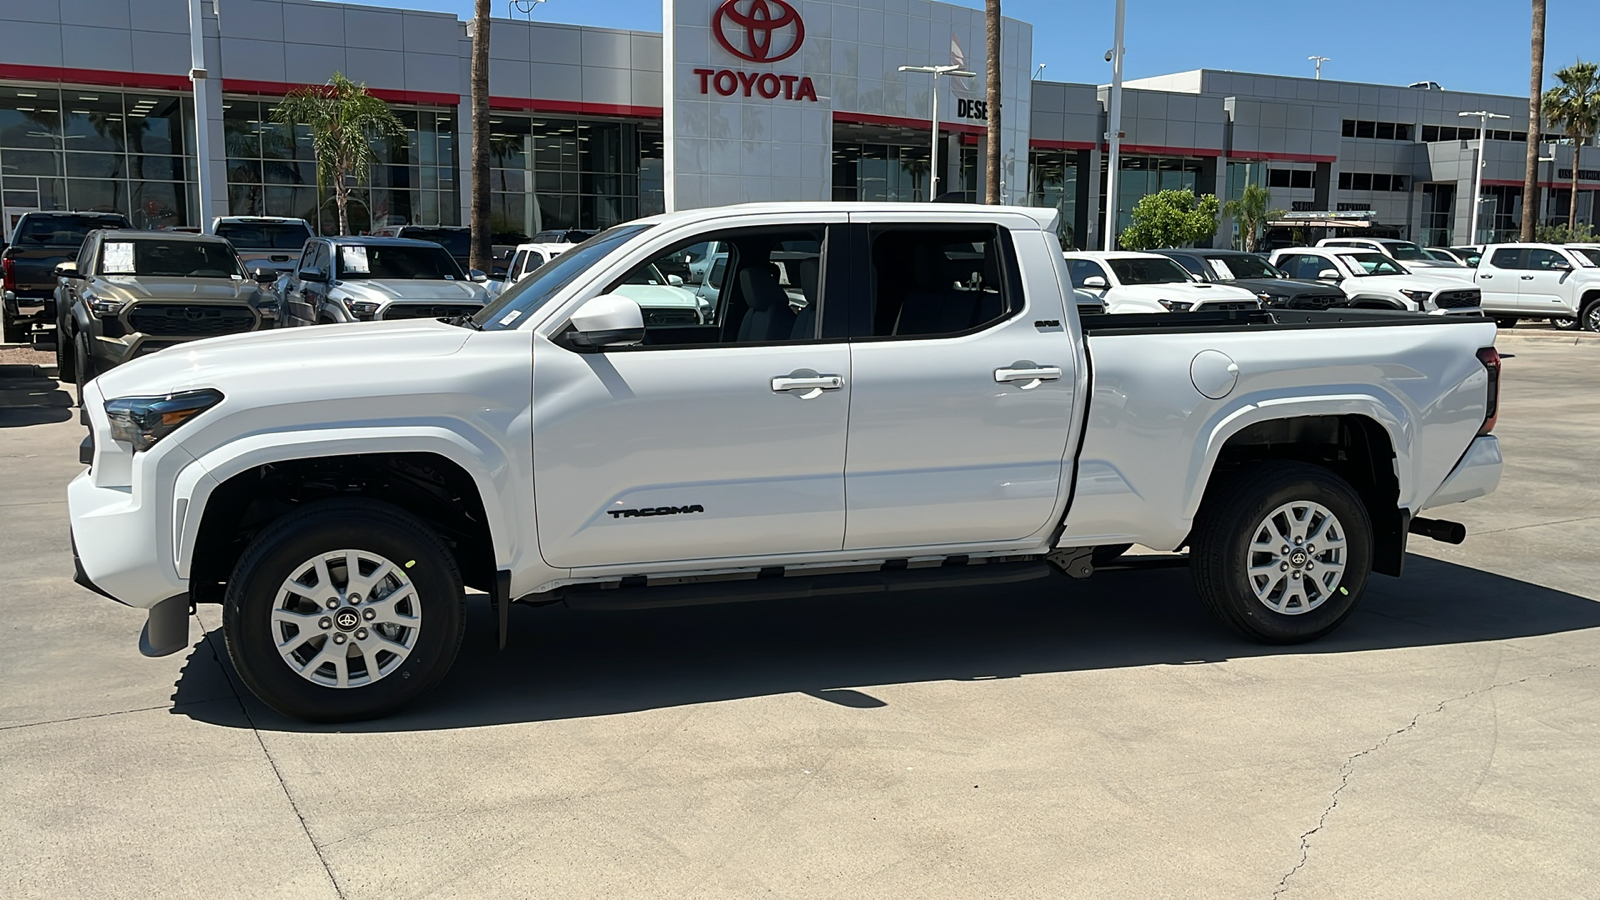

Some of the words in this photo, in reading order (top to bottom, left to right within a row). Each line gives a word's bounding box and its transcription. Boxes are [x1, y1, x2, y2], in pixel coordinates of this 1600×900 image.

[693, 68, 818, 102] TOYOTA
[957, 98, 1002, 120] DESE
[607, 504, 705, 518] TACOMA
